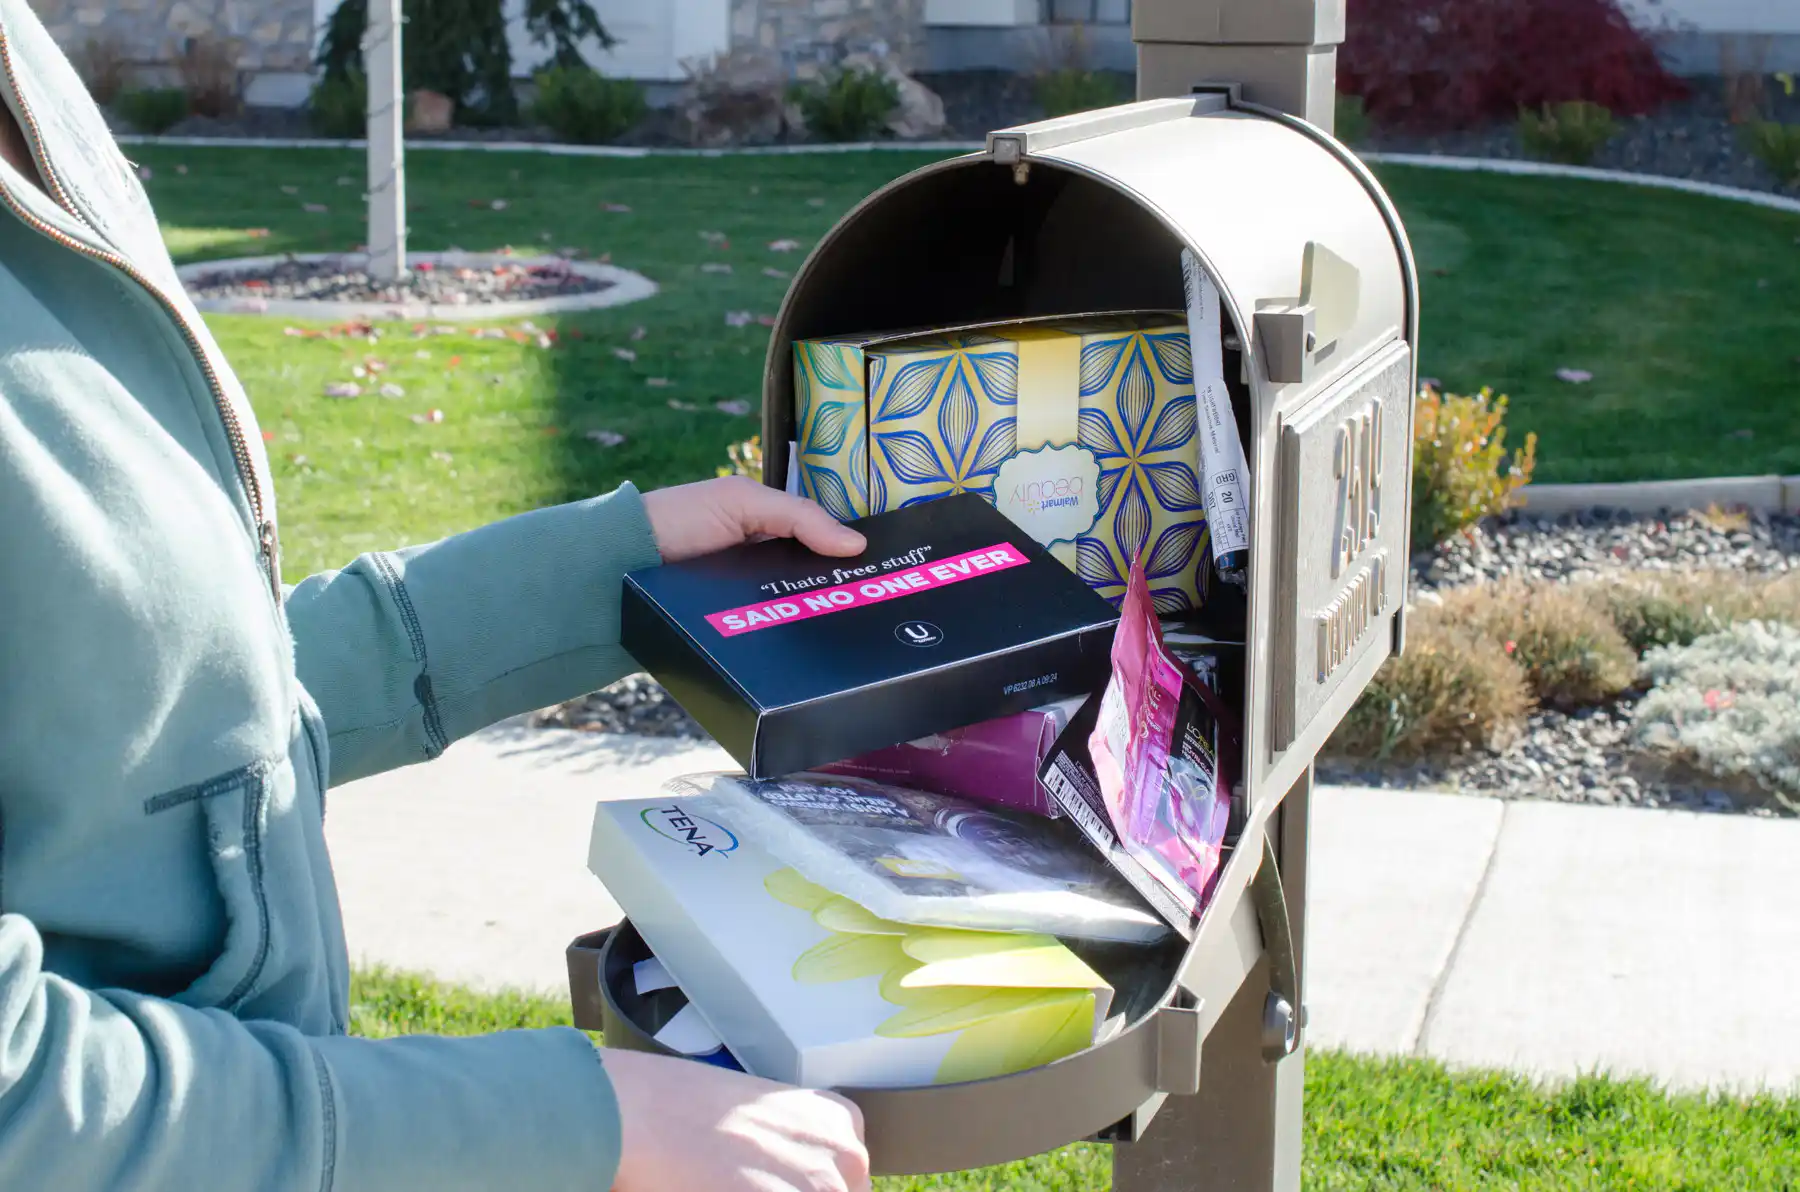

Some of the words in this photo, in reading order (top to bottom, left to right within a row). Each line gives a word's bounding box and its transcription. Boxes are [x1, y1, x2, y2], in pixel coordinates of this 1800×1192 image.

[1210, 430, 1220, 454] Material
[1215, 472, 1235, 485] GRD
[1009, 476, 1083, 507] beauty
[1041, 496, 1079, 511] Walmart
[1221, 491, 1234, 504] 20
[722, 603, 800, 630] SAID
[803, 590, 854, 612] NO
[860, 571, 924, 598] ONE
[929, 549, 1016, 582] EVER
[782, 573, 828, 593] hate
[832, 563, 878, 585] free
[904, 624, 928, 639] U
[661, 804, 714, 857] TENA
